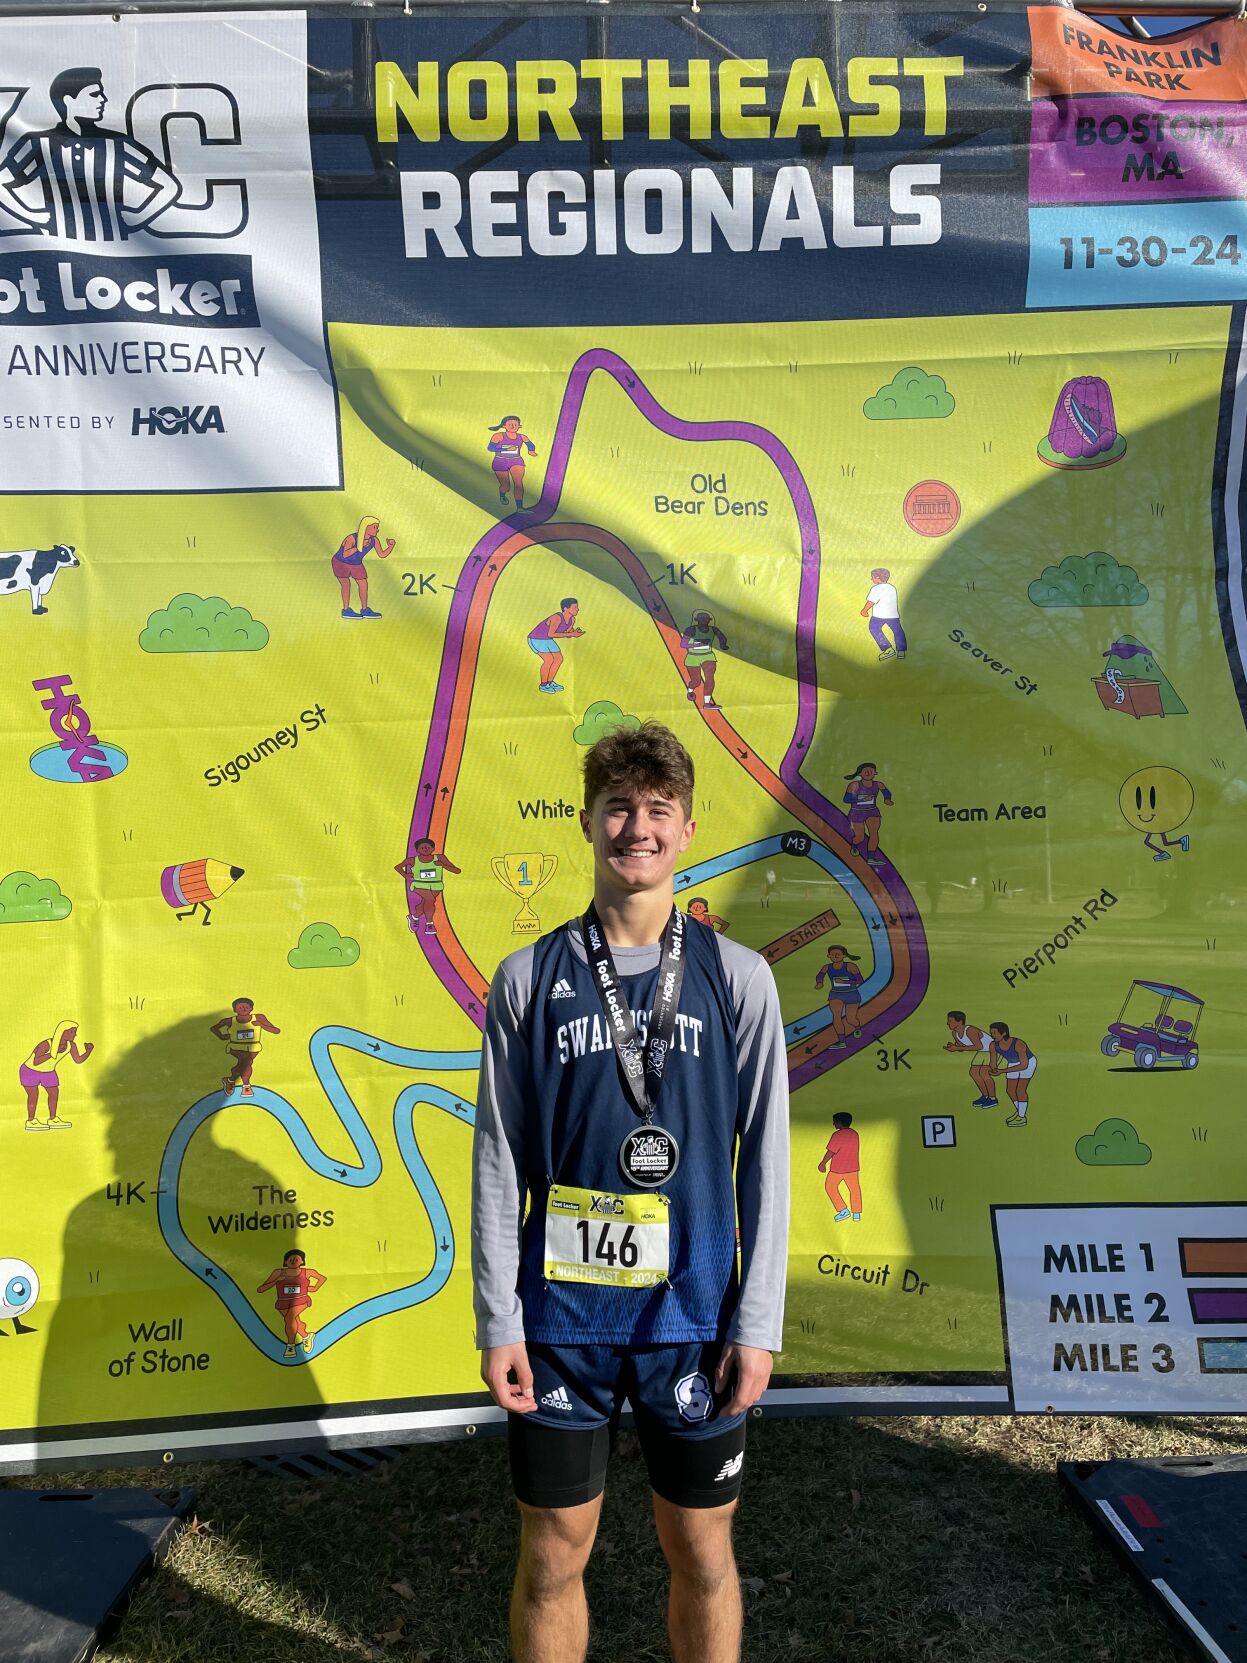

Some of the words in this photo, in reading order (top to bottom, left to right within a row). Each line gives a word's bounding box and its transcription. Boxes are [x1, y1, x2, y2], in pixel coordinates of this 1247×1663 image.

[1061, 22, 1221, 69] FRANKLIN
[1103, 60, 1193, 92] PARK
[375, 55, 963, 143] NORTHEAST
[1075, 112, 1237, 147] BOSTON,
[1121, 150, 1184, 183] MA
[401, 162, 942, 259] REGIONALS
[1059, 234, 1243, 271] 11-30-24
[59, 262, 242, 318] Locker
[8, 341, 266, 377] ANNIVERSARY
[91, 415, 115, 429] BY
[131, 405, 226, 436] HOKA
[690, 473, 727, 494] Old
[654, 496, 705, 516] Bear
[714, 496, 769, 517] Dens
[401, 572, 438, 596] 2K
[667, 562, 698, 586] 1K
[948, 628, 1015, 676] Seaver
[1014, 673, 1039, 697] St
[299, 703, 327, 732] St
[517, 798, 575, 820] White
[933, 803, 989, 824] Team
[995, 802, 1047, 821] Area
[786, 836, 807, 851] M3
[588, 924, 602, 953] HOKA
[789, 916, 832, 947] START!
[1002, 914, 1087, 988] Pierpont
[1083, 887, 1120, 921] Rd
[669, 934, 683, 961] Foot
[547, 990, 577, 1000] adidas
[597, 959, 613, 991] Foot
[605, 990, 627, 1033] Locker
[663, 972, 676, 1003] HOKA
[876, 1048, 913, 1072] 3K
[933, 1122, 946, 1142] P
[107, 1181, 146, 1207] 4K
[252, 1185, 297, 1206] The
[207, 1209, 335, 1235] Wilderness
[576, 1220, 638, 1268] 146
[1043, 1243, 1124, 1274] MILE
[1139, 1243, 1155, 1273] 1
[555, 1265, 620, 1283] NORTHEAST
[631, 1272, 657, 1284] 2024
[817, 1253, 891, 1287] Circuit
[902, 1269, 931, 1297] Dr
[1049, 1294, 1132, 1324] MILE
[1144, 1293, 1170, 1323] 2
[128, 1318, 184, 1344] Wall
[107, 1352, 135, 1378] of
[141, 1349, 210, 1374] Stone
[1053, 1343, 1139, 1373] MILE
[1152, 1343, 1176, 1373] 3
[540, 1396, 573, 1412] adidas
